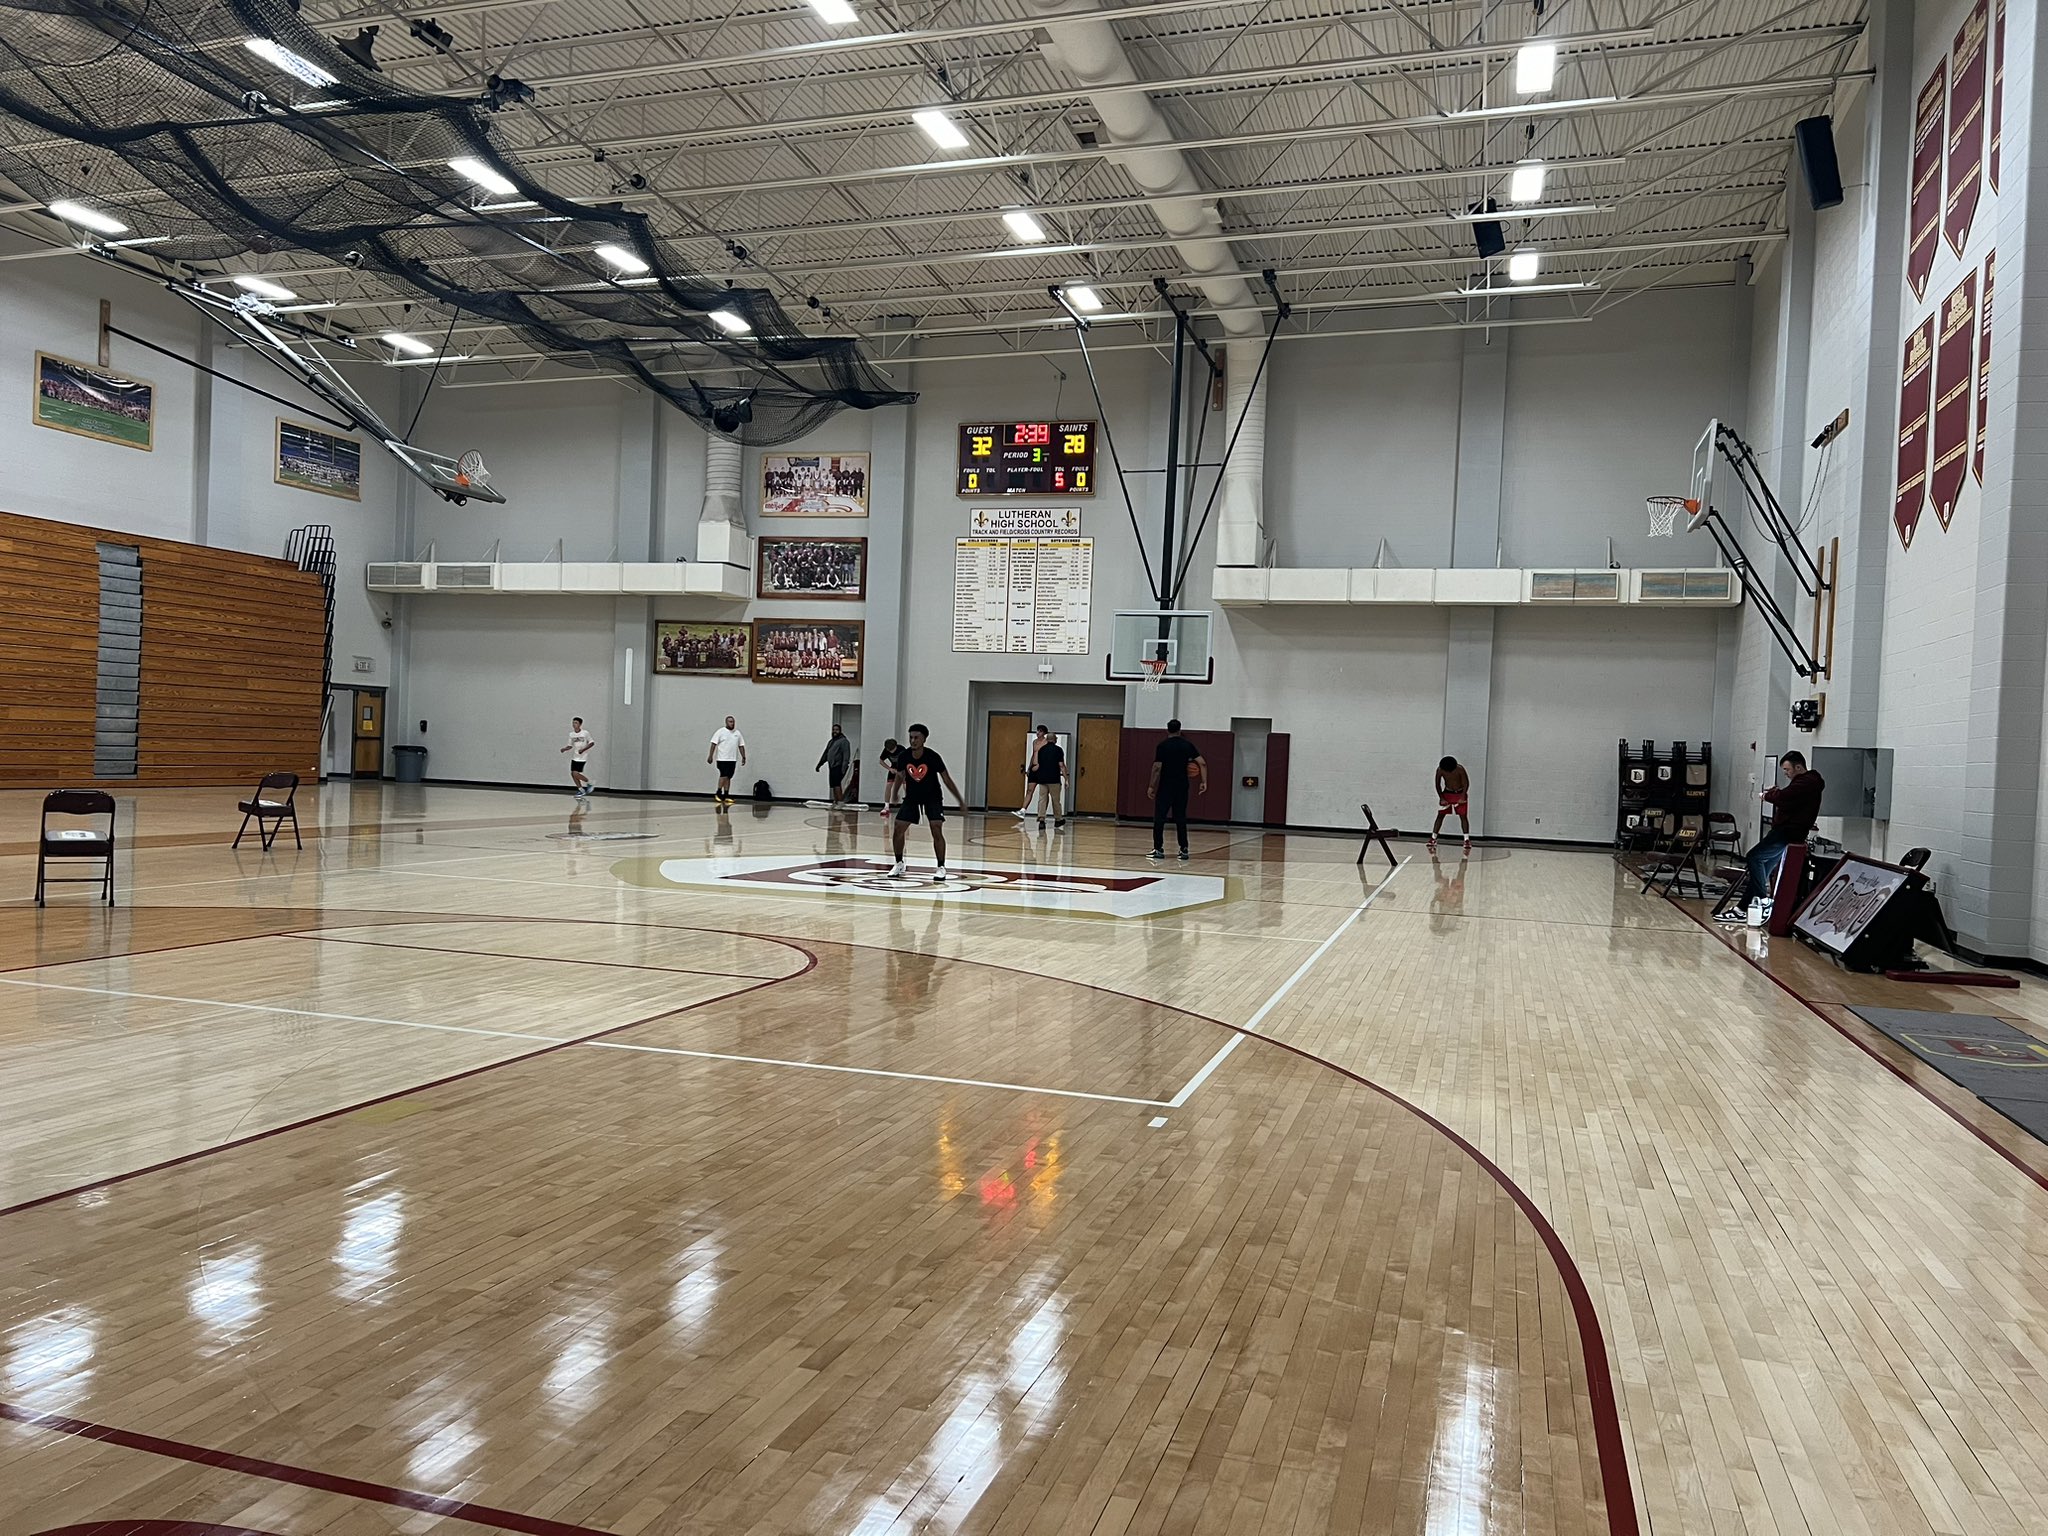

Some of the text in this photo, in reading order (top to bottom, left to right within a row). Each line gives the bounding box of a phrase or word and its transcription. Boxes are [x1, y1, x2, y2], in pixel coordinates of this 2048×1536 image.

[966, 426, 994, 434] GUEST
[1014, 424, 1048, 443] 2:39
[1058, 424, 1088, 433] SAINTS
[972, 436, 992, 456] 32
[1064, 434, 1085, 454] 28
[1003, 448, 1041, 462] PERIOD 3
[968, 474, 978, 488] 0
[1055, 472, 1064, 487] 5
[1076, 472, 1086, 487] 0
[998, 510, 1051, 518] LUTHERAN
[991, 519, 1058, 528] HIGH SCHOOL
